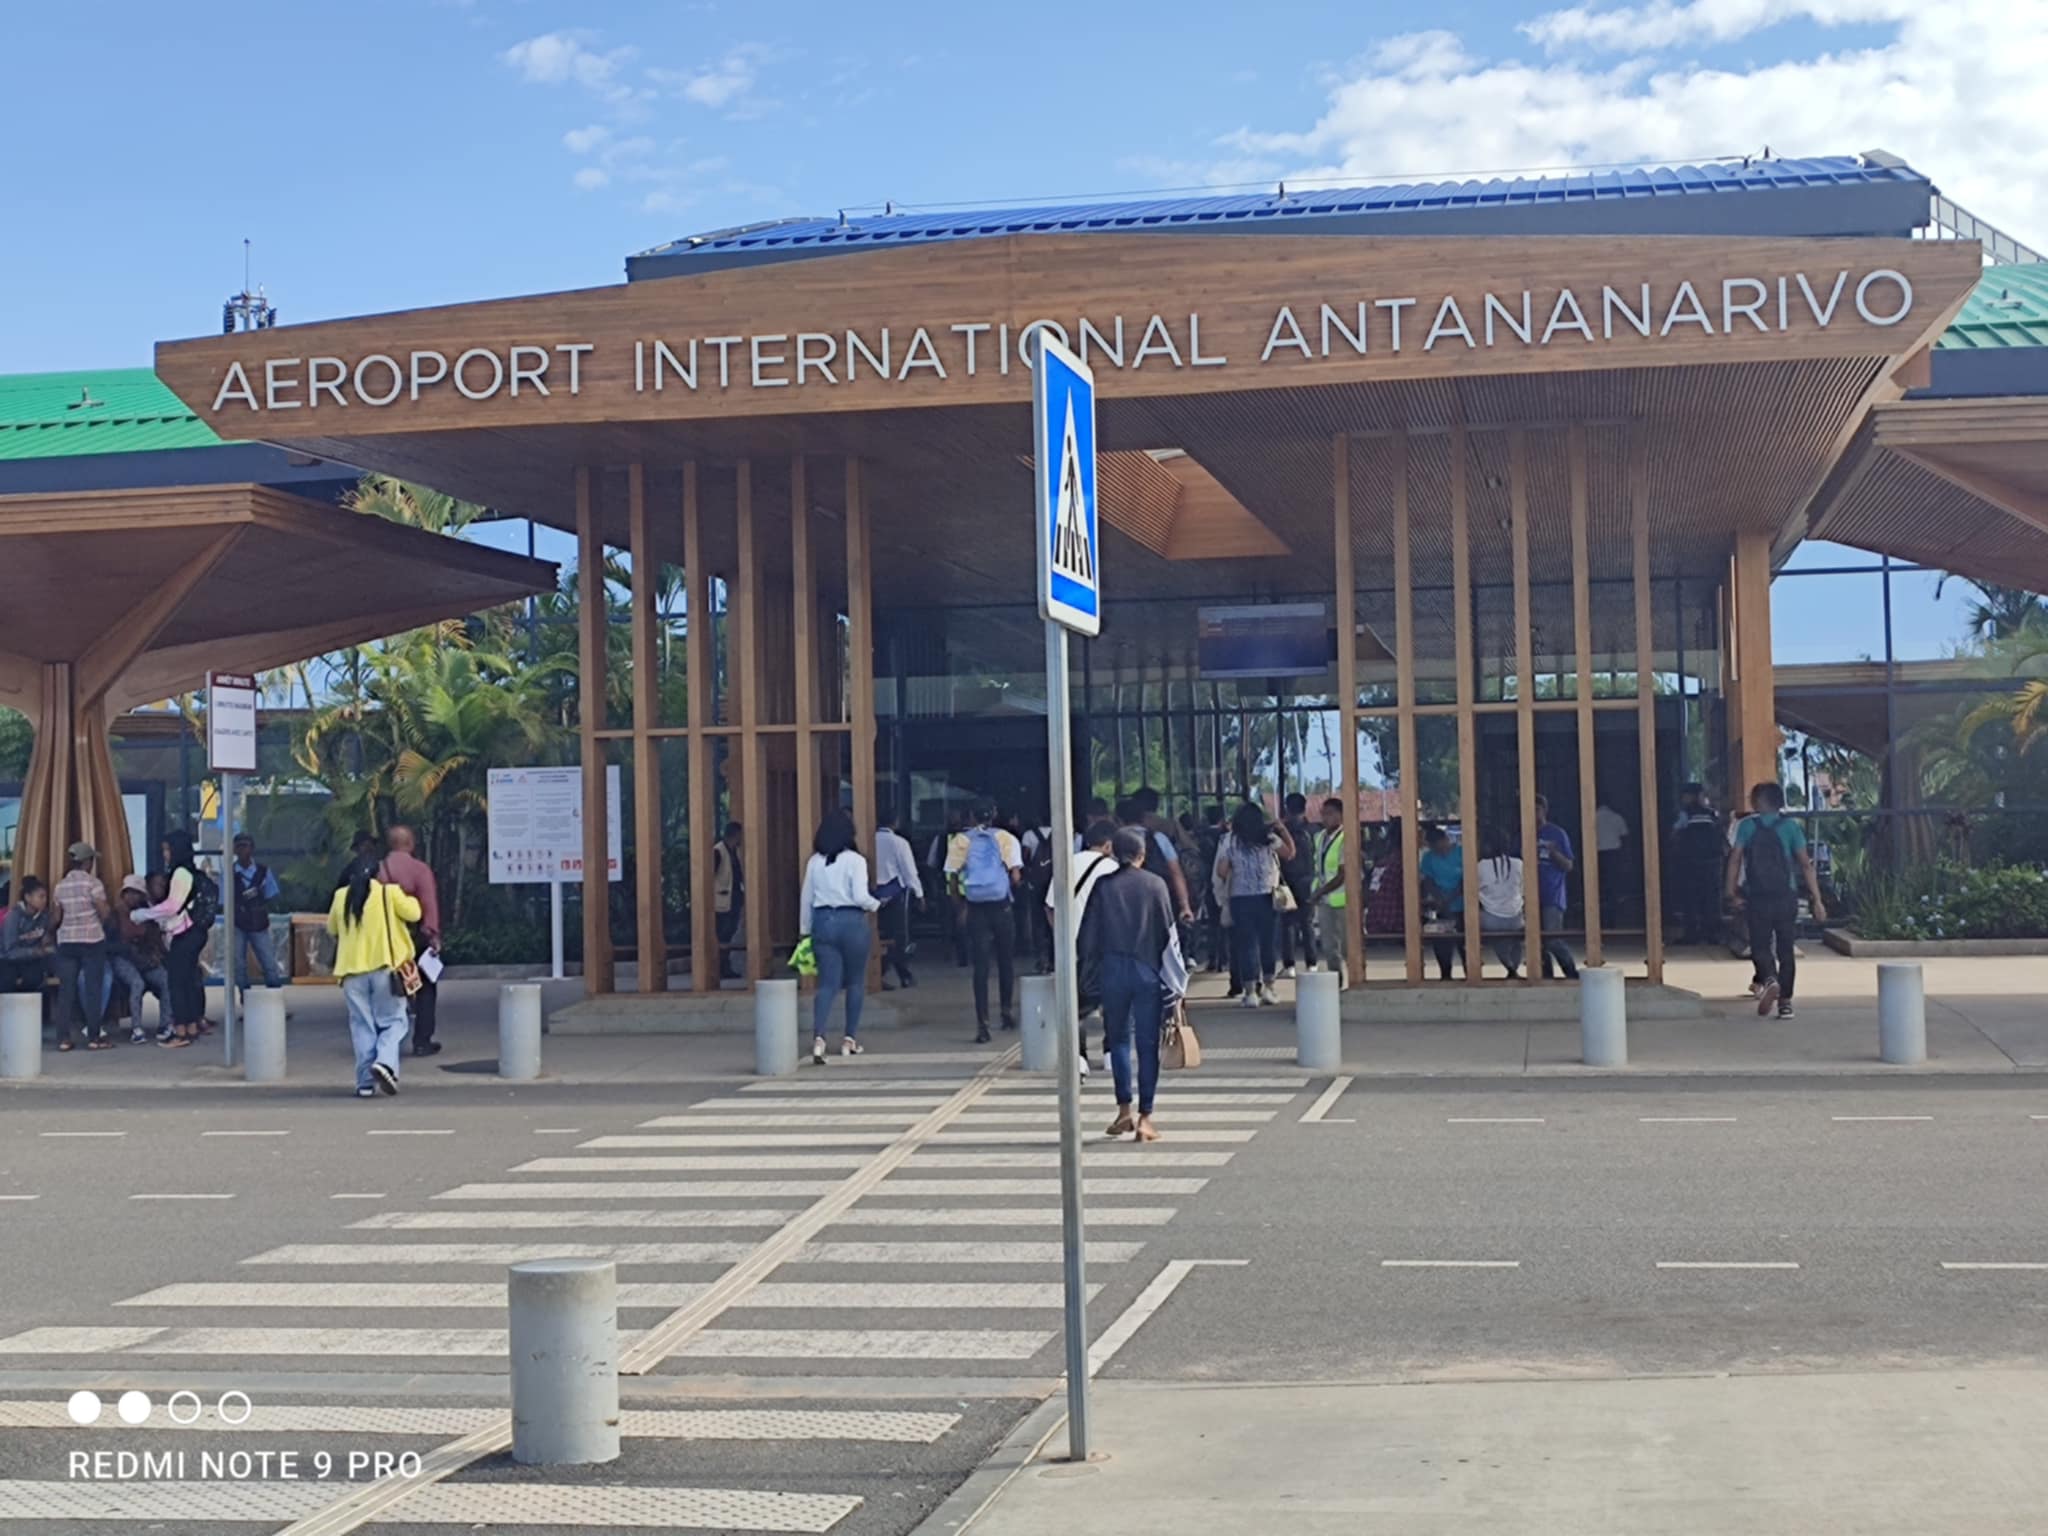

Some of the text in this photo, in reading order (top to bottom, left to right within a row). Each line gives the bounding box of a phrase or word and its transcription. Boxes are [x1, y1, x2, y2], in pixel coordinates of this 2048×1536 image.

[212, 269, 1912, 411] AEROPORT INTERNATIONAL ANTANANARIVO
